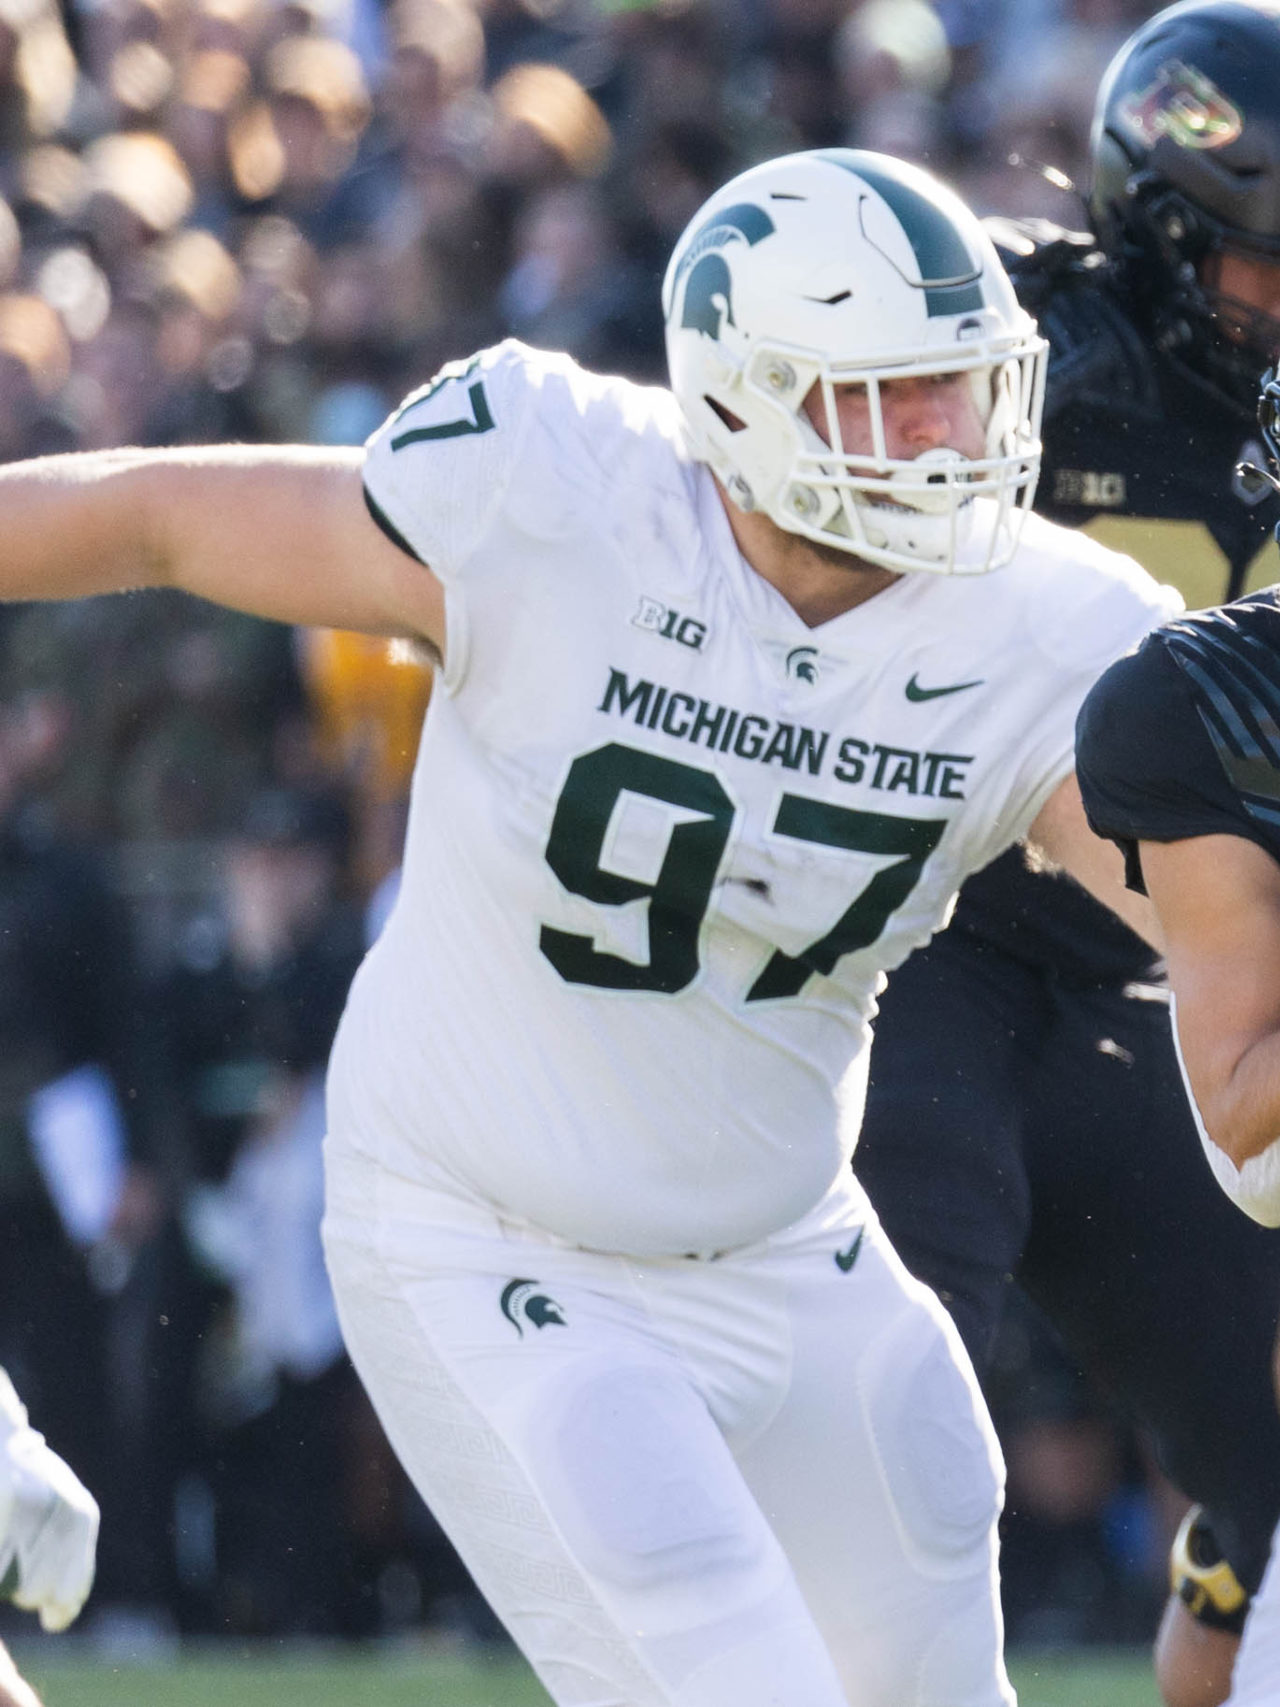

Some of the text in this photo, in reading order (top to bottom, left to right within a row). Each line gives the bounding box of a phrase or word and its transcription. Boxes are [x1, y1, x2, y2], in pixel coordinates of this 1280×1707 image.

[597, 666, 976, 800] MICHIGAN STATE
[539, 742, 948, 1003] 97
